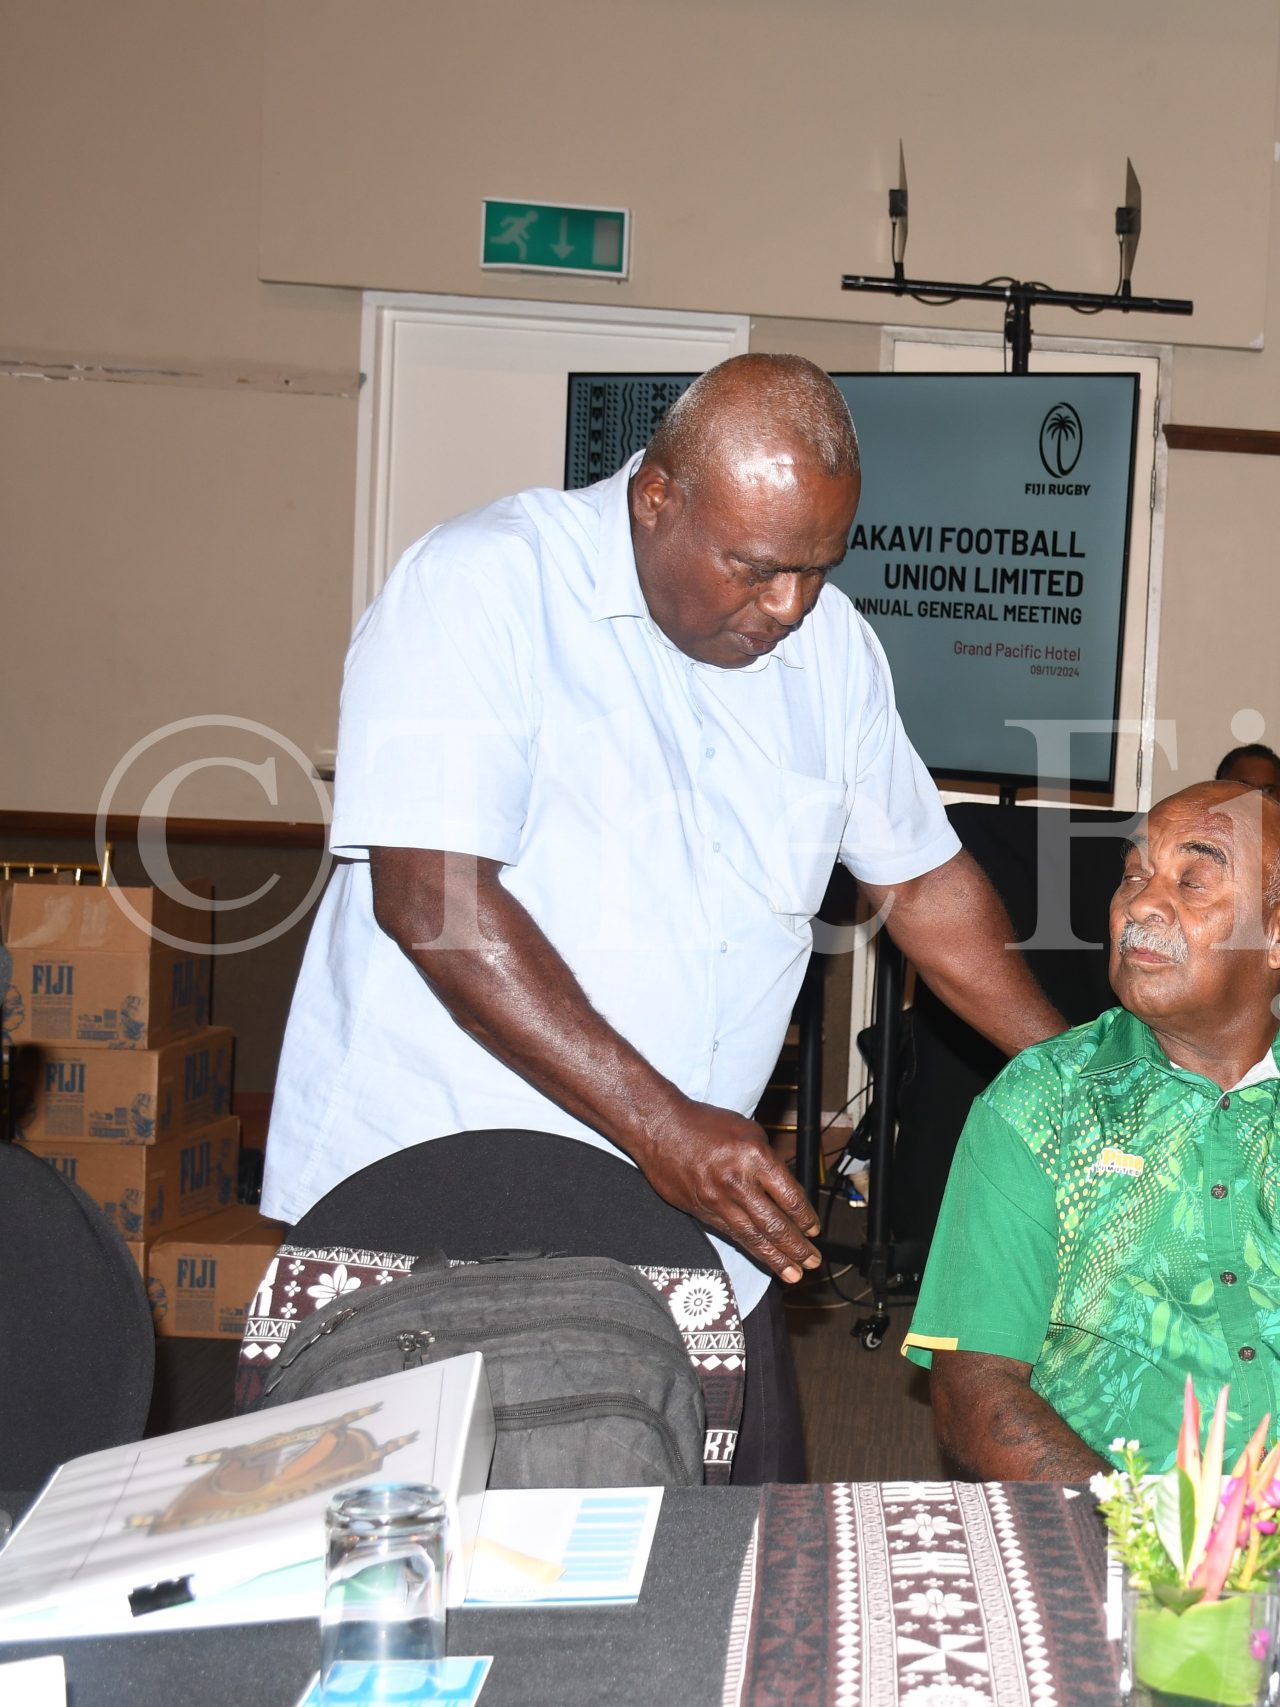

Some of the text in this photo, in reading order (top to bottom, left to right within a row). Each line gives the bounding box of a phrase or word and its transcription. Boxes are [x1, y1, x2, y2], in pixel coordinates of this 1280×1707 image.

[1025, 483, 1091, 496] FIJI RUGBY
[846, 524, 1086, 558] AKAVI FOOTBALL
[884, 563, 1084, 597] UNION LIMITED
[853, 597, 1082, 625] NNUAL GENERAL MEETING
[954, 641, 1081, 662] Grand Pacific Hotel
[1030, 664, 1080, 678] 09/11/2024
[32, 965, 73, 995] FIJI
[45, 1063, 86, 1093] FIJI
[177, 1259, 216, 1288] FIJI
